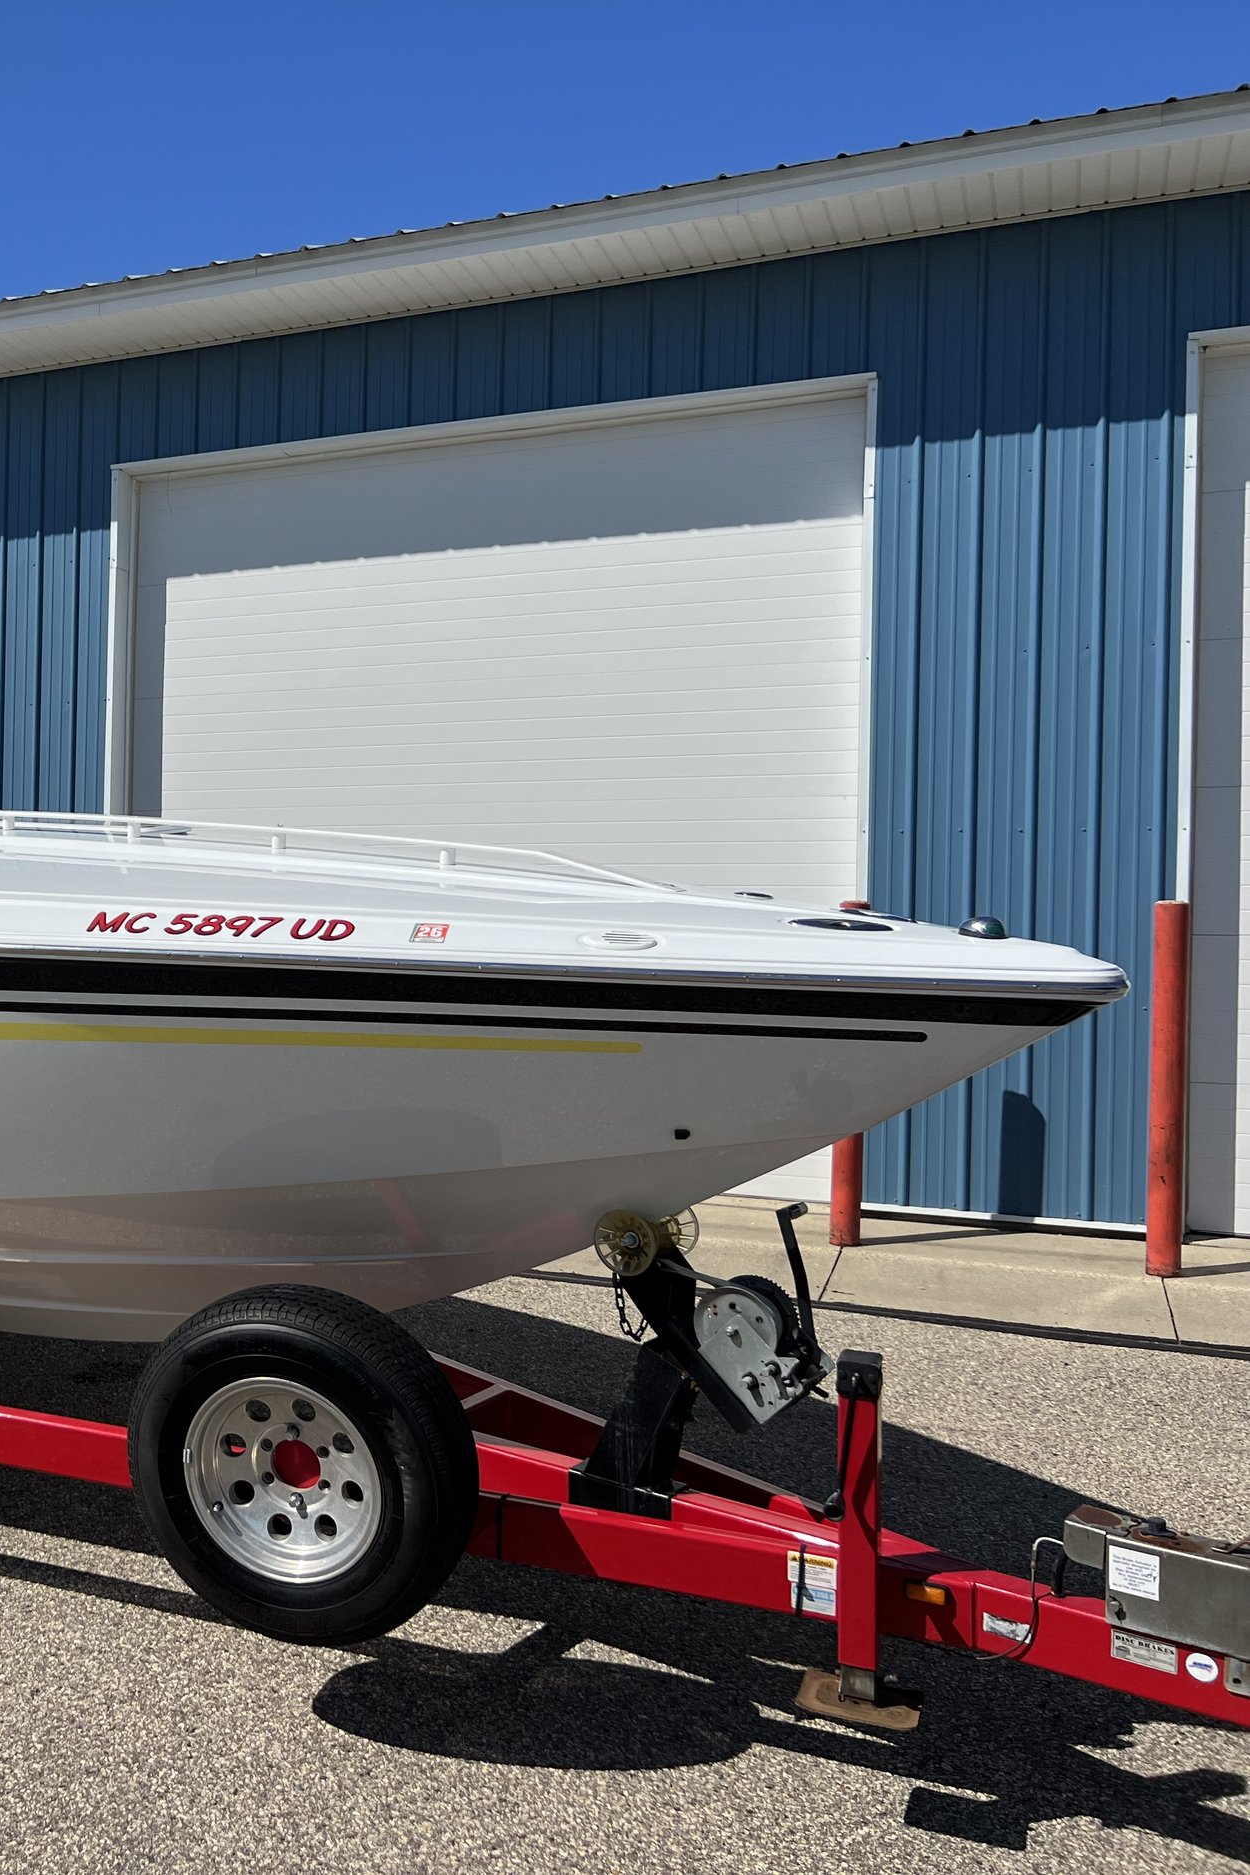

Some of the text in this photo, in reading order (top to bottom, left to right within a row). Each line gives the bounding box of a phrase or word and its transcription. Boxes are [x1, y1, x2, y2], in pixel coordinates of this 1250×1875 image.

[86, 911, 356, 942] MC 5897 UD
[416, 926, 444, 938] 26
